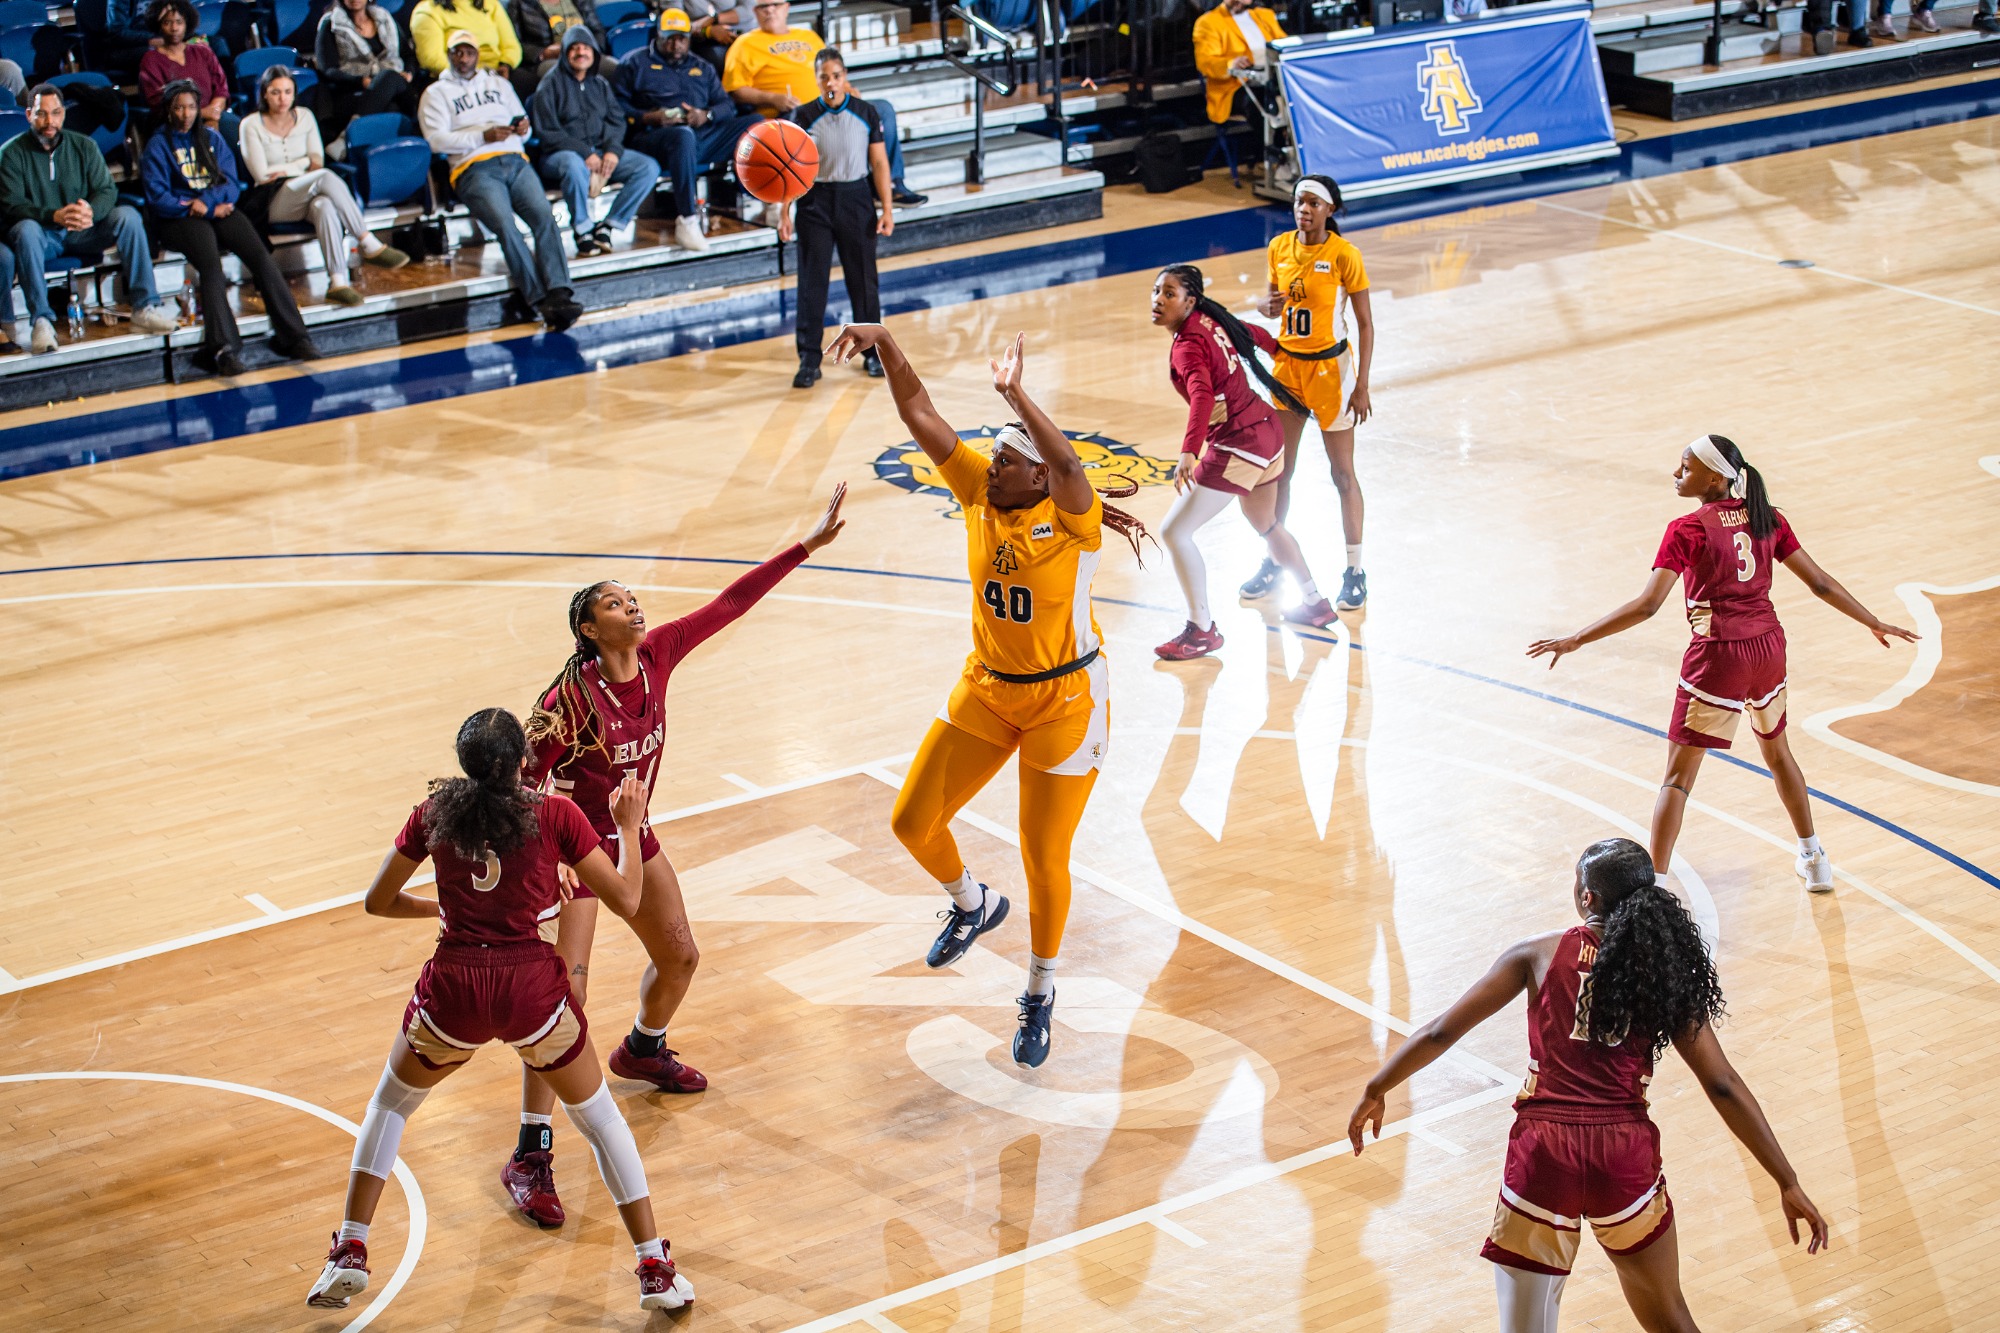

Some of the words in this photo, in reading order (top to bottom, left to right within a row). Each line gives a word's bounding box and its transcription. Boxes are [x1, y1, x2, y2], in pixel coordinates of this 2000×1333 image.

[1381, 131, 1540, 170] www.ncataggies.com
[1285, 306, 1313, 338] 10
[1032, 526, 1051, 536] CAA
[1733, 531, 1757, 582] 3
[983, 578, 1033, 625] 40
[613, 723, 662, 764] ELON
